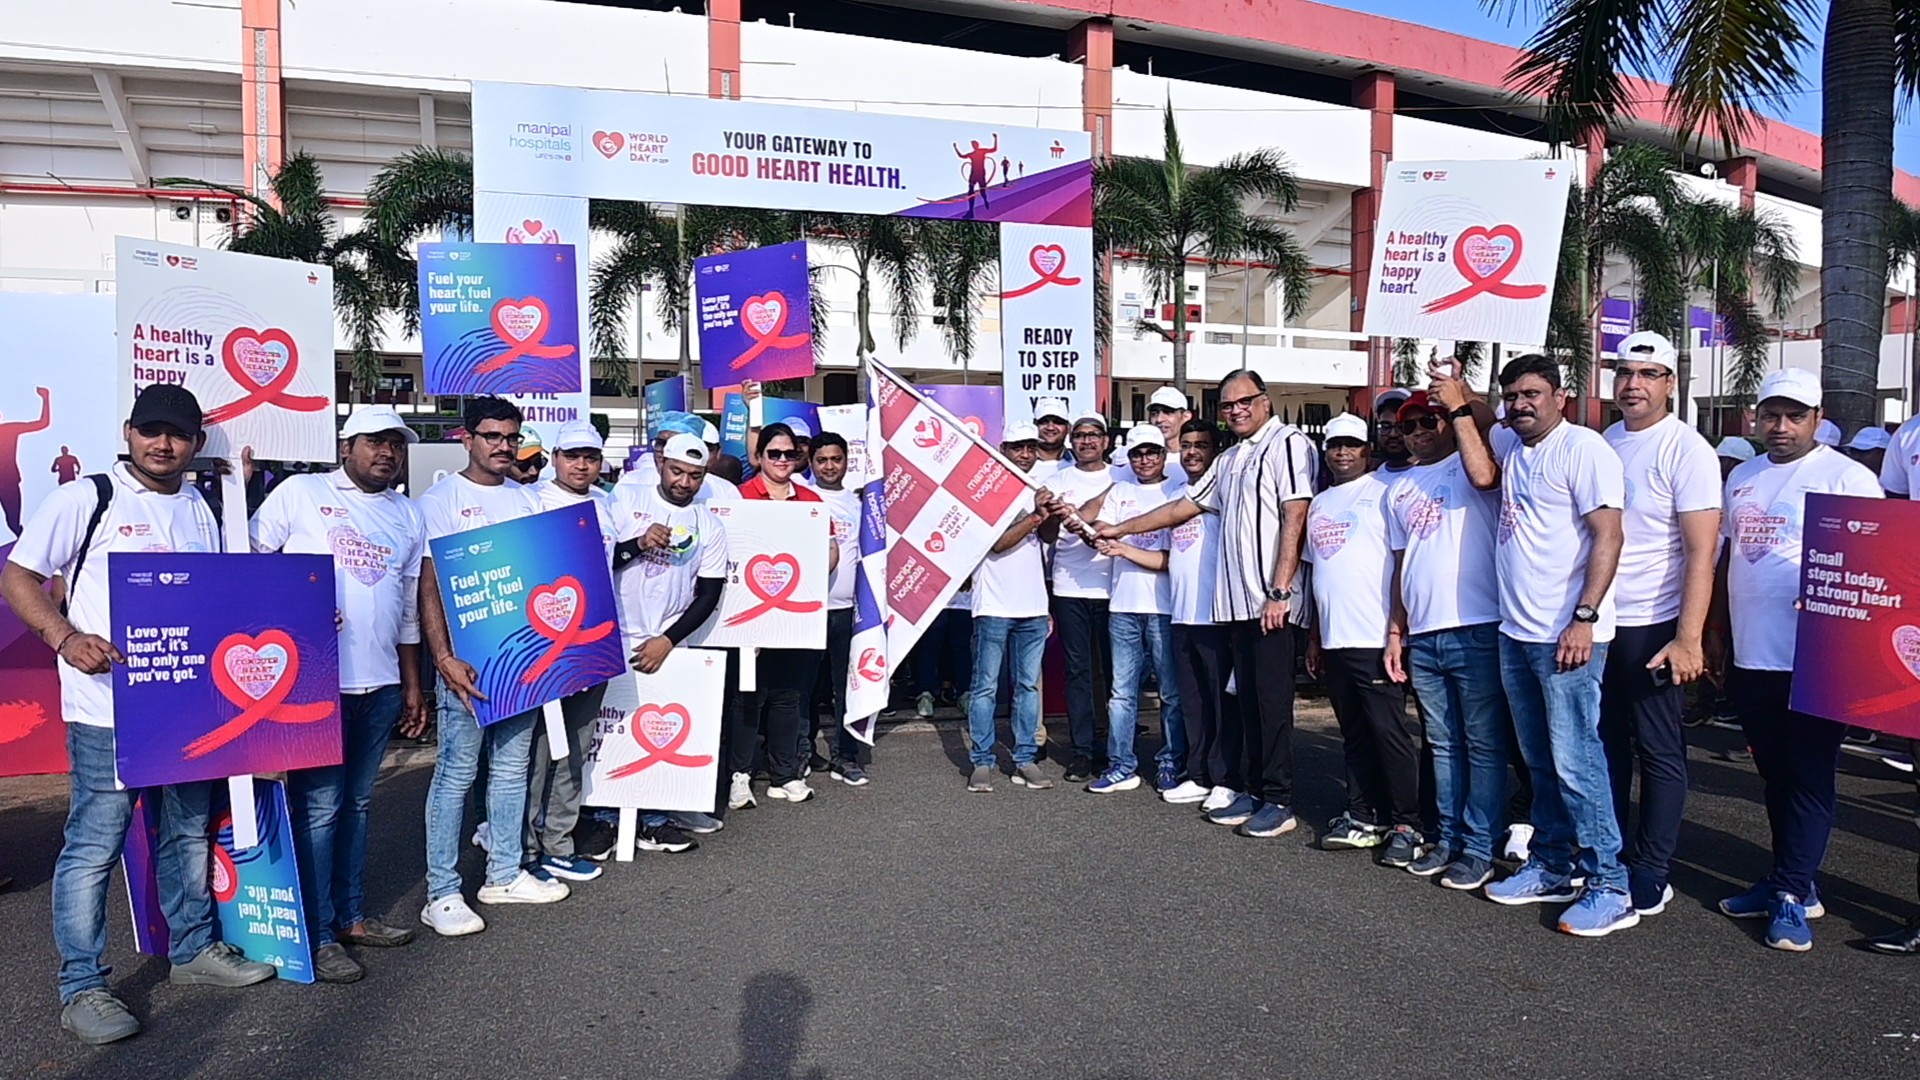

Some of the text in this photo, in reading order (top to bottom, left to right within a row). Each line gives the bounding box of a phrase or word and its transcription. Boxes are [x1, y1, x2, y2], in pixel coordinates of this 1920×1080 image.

[517, 122, 572, 137] manipal
[629, 132, 668, 144] WORLD
[509, 135, 572, 152] hospitals
[630, 143, 664, 154] HEART
[723, 131, 872, 160] YOUR GATEWAY TO
[630, 153, 650, 162] DAY
[692, 152, 906, 190] GOOD HEART HEALTH.
[1386, 231, 1448, 249] A healthy
[1384, 248, 1446, 262] heart is a
[428, 272, 484, 287] Fuel your
[1382, 264, 1422, 281] happy
[429, 286, 491, 300] heart, fuel
[1380, 280, 1418, 294] heart.
[430, 300, 484, 316] your life.
[133, 324, 213, 350] A healthy
[1024, 328, 1073, 345] READY
[133, 343, 214, 366] heart is a
[1018, 351, 1079, 368] TO STEP
[134, 364, 186, 386] happy
[1022, 374, 1076, 391] UP FOR
[967, 457, 996, 490] manipa
[938, 505, 958, 529] WORLD
[944, 512, 963, 534] HEART
[1738, 515, 1786, 525] CONQUER
[950, 524, 963, 539] DAY
[1744, 526, 1777, 534] HEART
[338, 538, 392, 555] CONQUER
[1740, 536, 1779, 544] HEALTH
[348, 548, 384, 561] HEART
[1809, 549, 1844, 567] Small
[344, 558, 388, 570] HEALTH
[450, 564, 512, 591] Fuel your
[889, 556, 916, 590] manipal
[1808, 567, 1888, 591] steps today,
[893, 565, 925, 602] hospitals
[454, 577, 523, 608] heart, fuel
[1806, 584, 1902, 608] a strong heart
[458, 599, 518, 629] your life.
[1806, 598, 1872, 621] tomorrow.
[127, 625, 190, 643] Love your
[127, 639, 188, 654] heart, it's
[128, 654, 205, 669] the only one
[128, 668, 197, 686] you've got.
[604, 720, 624, 734] is a
[244, 885, 295, 902] your life.
[238, 902, 297, 924] heart, fuel
[249, 921, 300, 944] Fuel your
